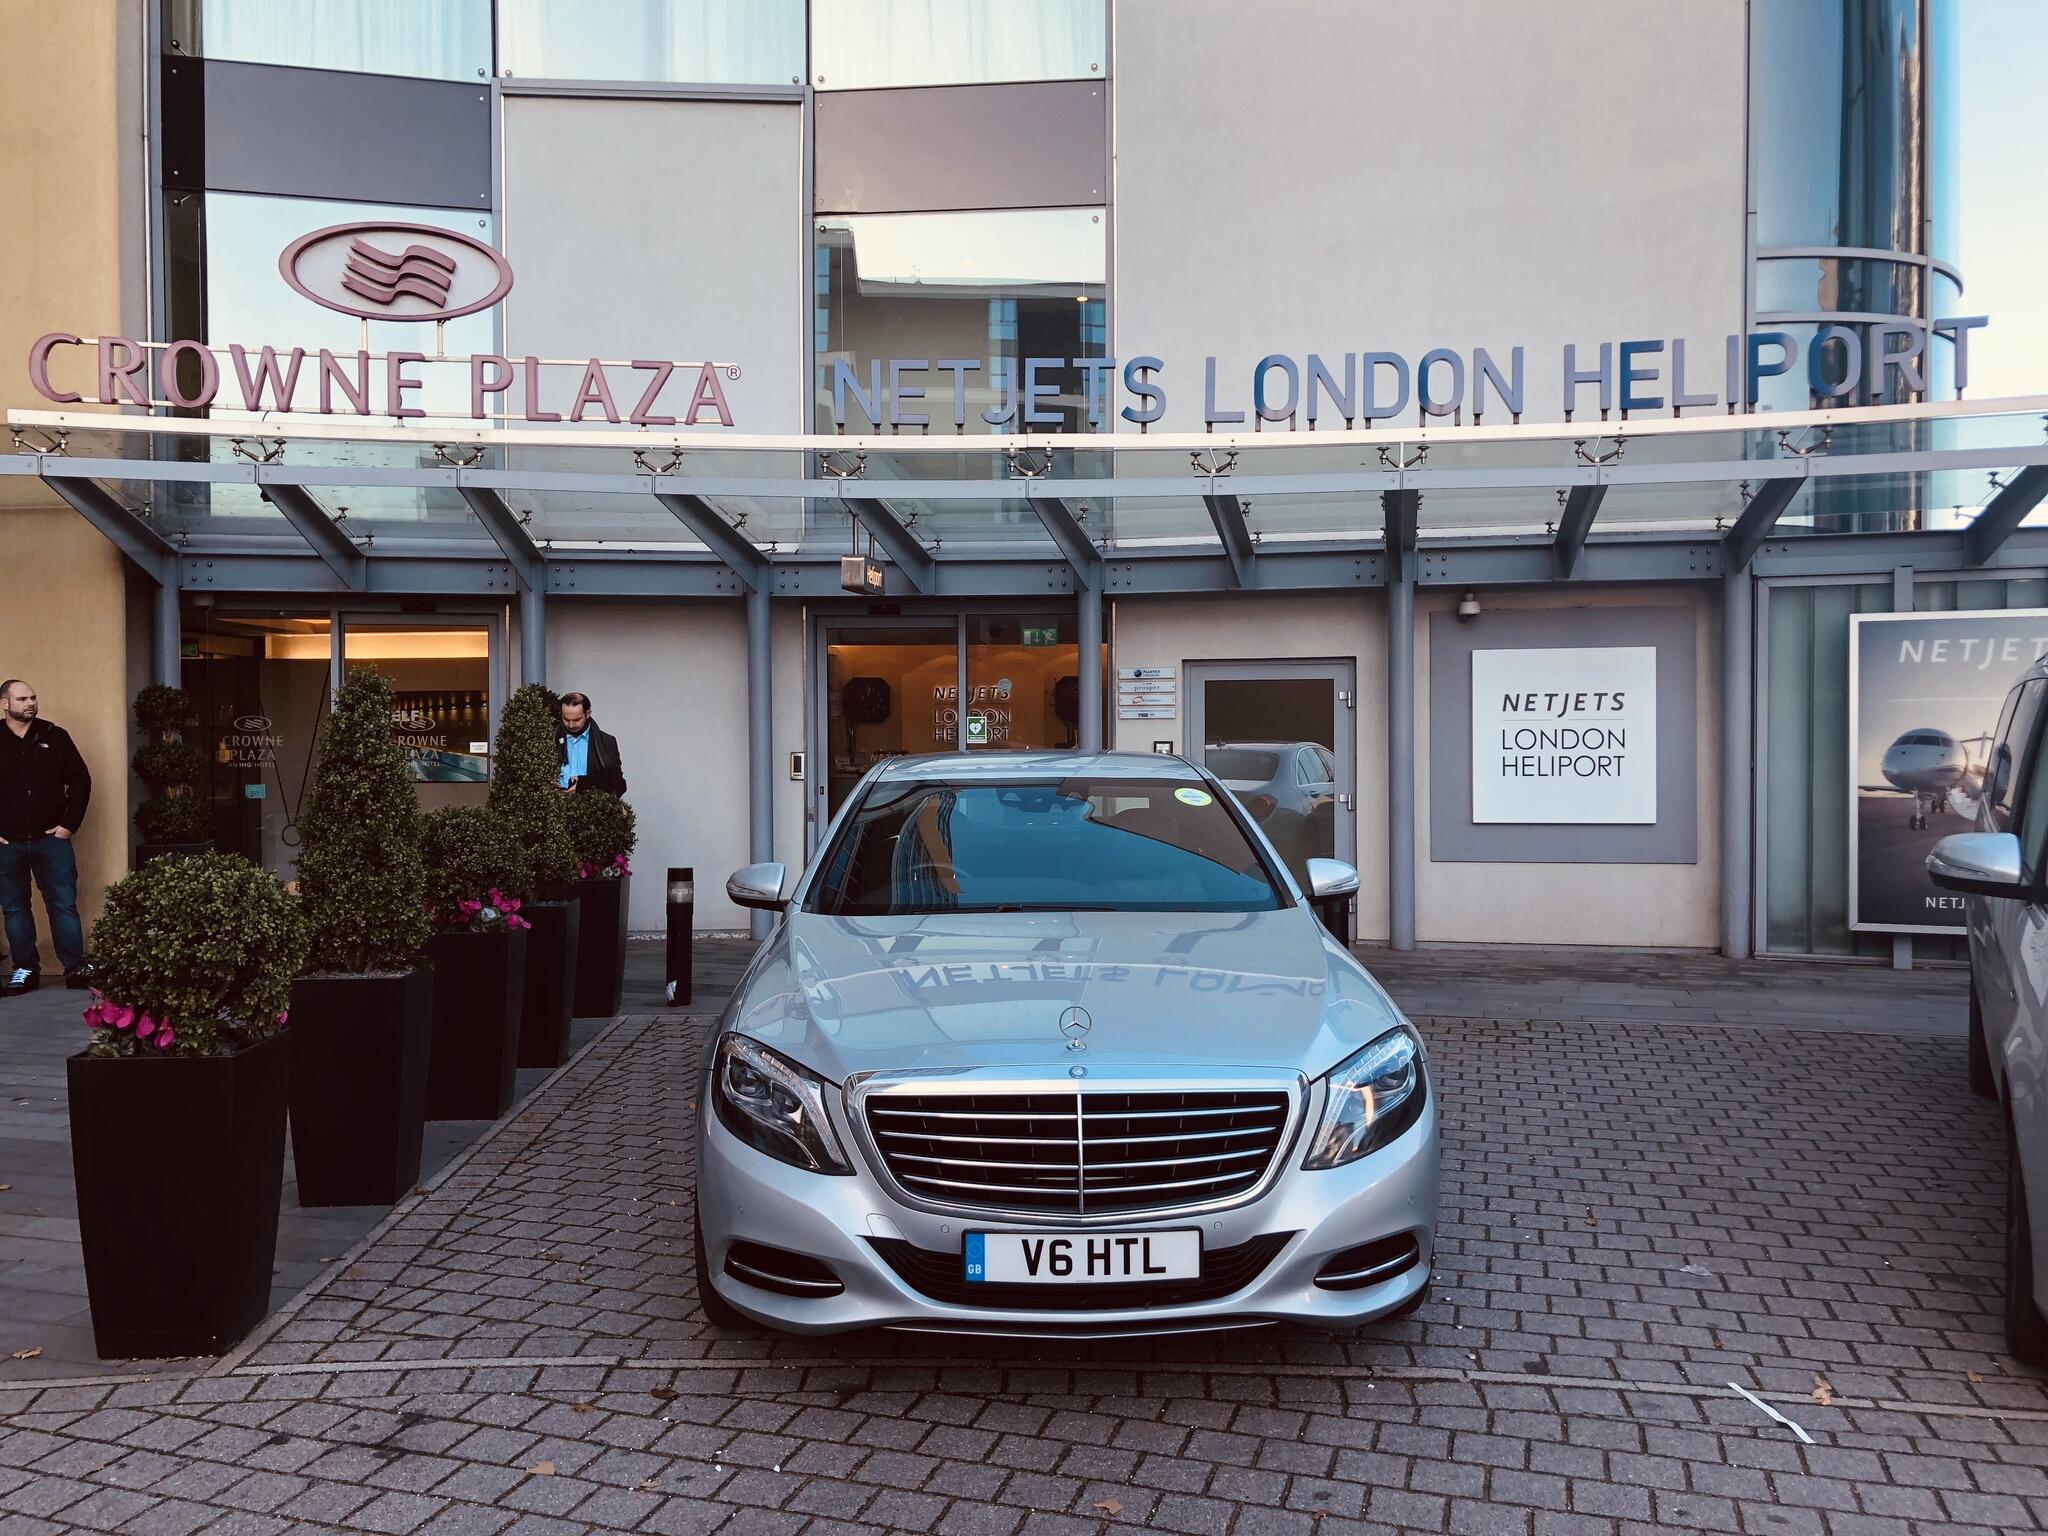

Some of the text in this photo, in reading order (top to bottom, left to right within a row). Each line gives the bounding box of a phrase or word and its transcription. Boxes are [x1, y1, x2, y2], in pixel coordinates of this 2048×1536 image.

[28, 332, 427, 418] CROWNE
[833, 315, 1990, 425] NETJETS LONDON HELIPORT
[934, 686, 1010, 704] NEJETS
[1502, 692, 1626, 718] NETJETS
[934, 708, 1011, 725] LODON
[222, 735, 285, 747] CROWNE
[934, 727, 1009, 742] HERT
[1502, 728, 1626, 750] LONDON
[230, 749, 276, 761] PLAZA
[1502, 755, 1626, 777] HELIPORT
[1925, 896, 1965, 909] NETJ
[1021, 1237, 1166, 1276] V6 HTL
[967, 1263, 982, 1275] GB
